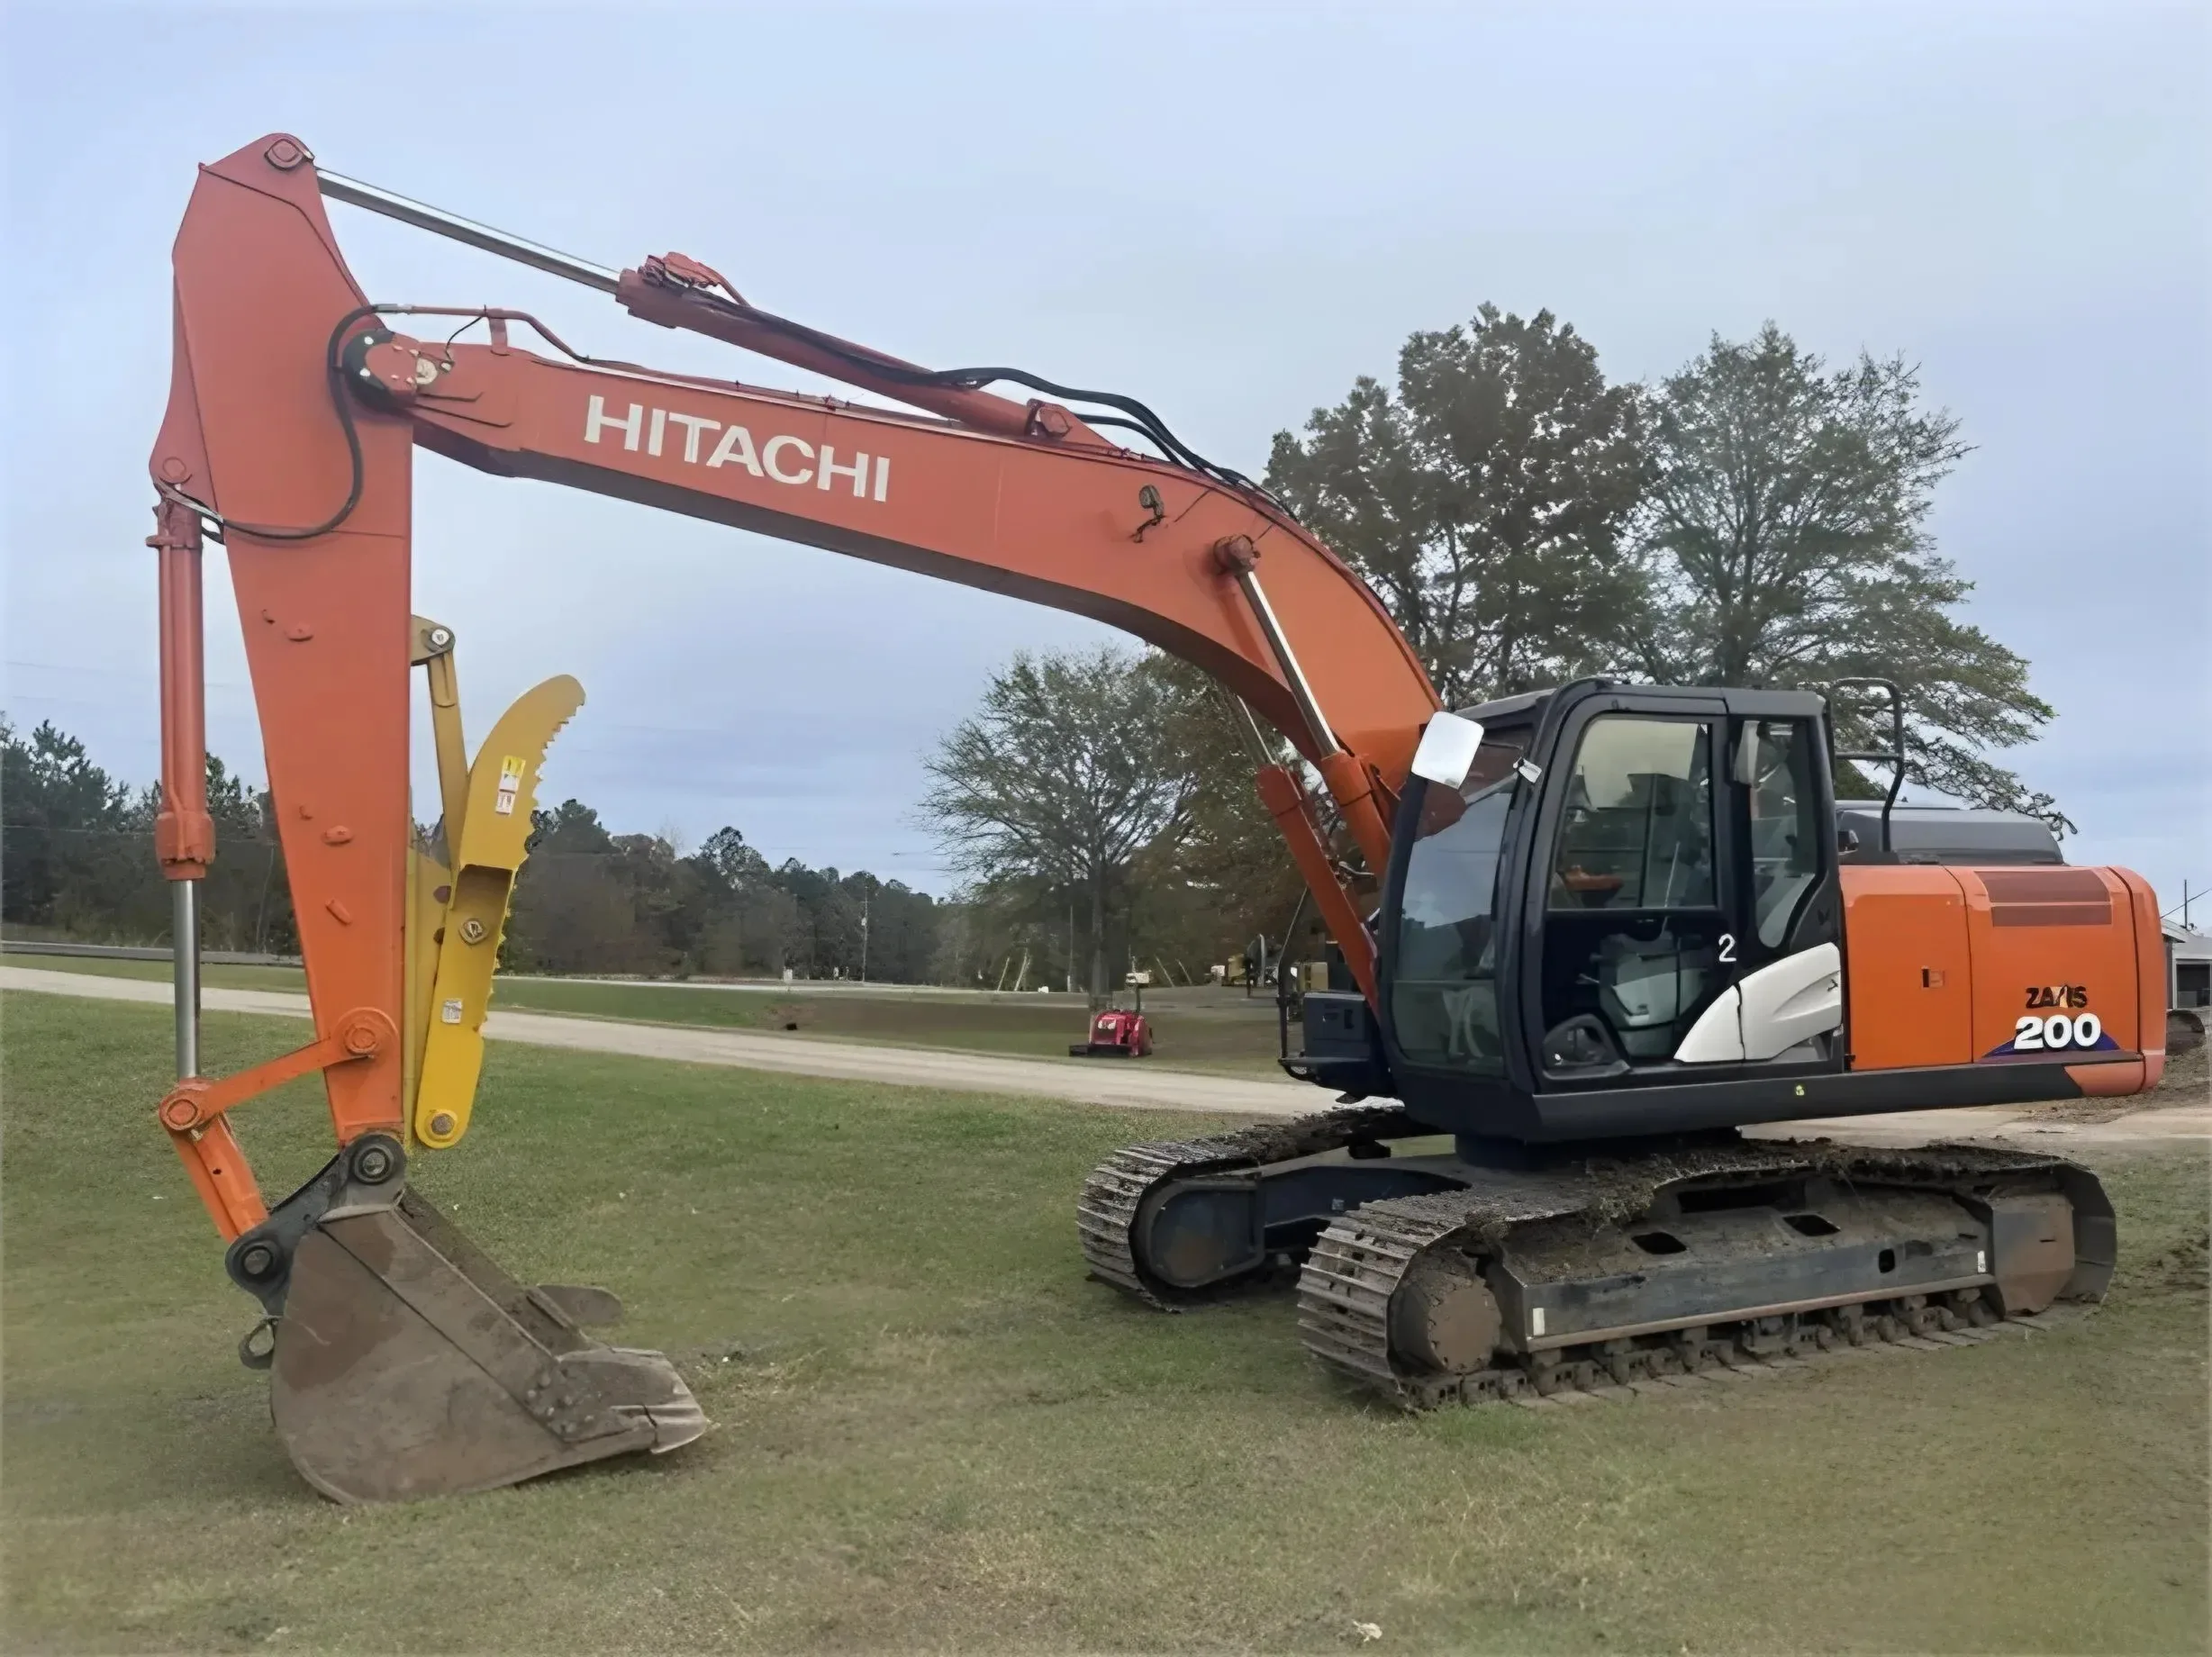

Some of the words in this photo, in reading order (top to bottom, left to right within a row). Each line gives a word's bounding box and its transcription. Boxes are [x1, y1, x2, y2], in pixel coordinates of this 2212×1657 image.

[584, 394, 891, 503] HITACHI
[1718, 933, 1737, 963] 2
[2013, 1012, 2101, 1051] 200
